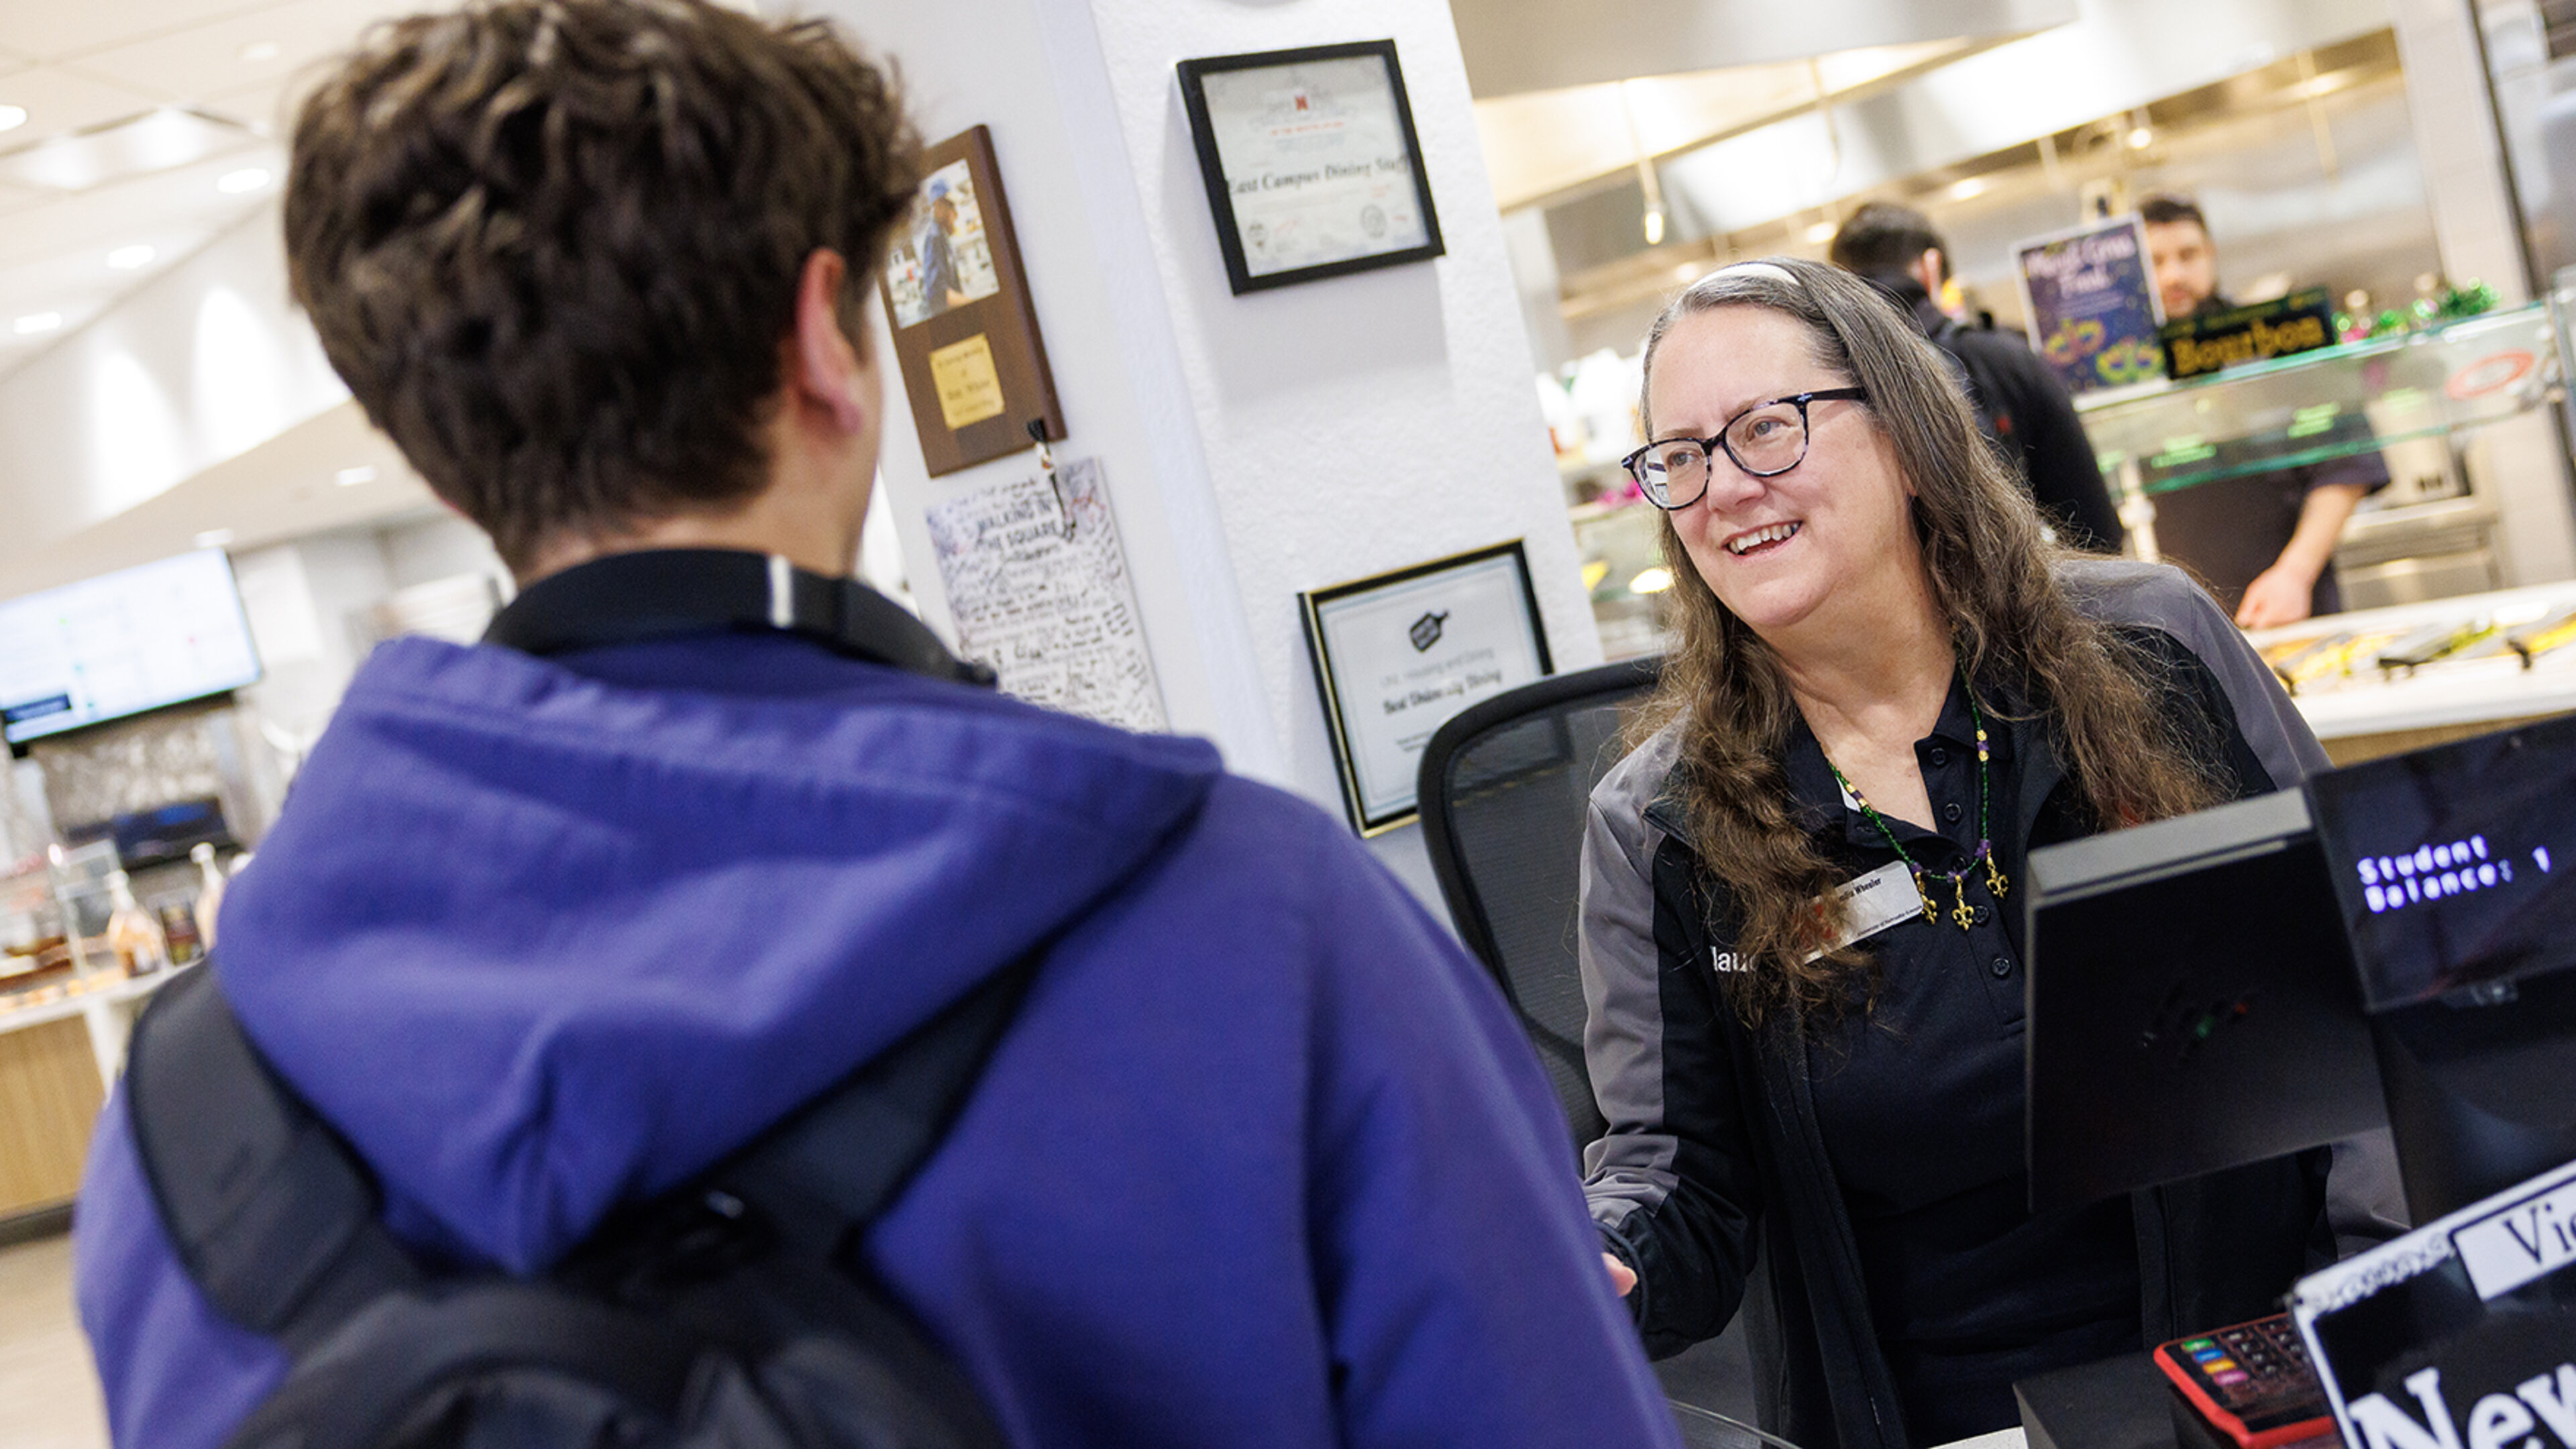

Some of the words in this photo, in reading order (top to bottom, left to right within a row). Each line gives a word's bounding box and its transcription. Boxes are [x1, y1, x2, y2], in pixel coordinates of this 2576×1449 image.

[1228, 176, 1258, 193] East
[1261, 170, 1320, 190] Campus
[1324, 163, 1372, 181] Dining
[2171, 317, 2326, 376] Bourbon
[977, 504, 1035, 531] WALKING
[1006, 519, 1057, 548] SQUARE
[1383, 698, 1407, 716] Best
[2356, 833, 2489, 885] Student
[1854, 878, 1881, 895] Wheeler
[2502, 1202, 2576, 1266] Vi
